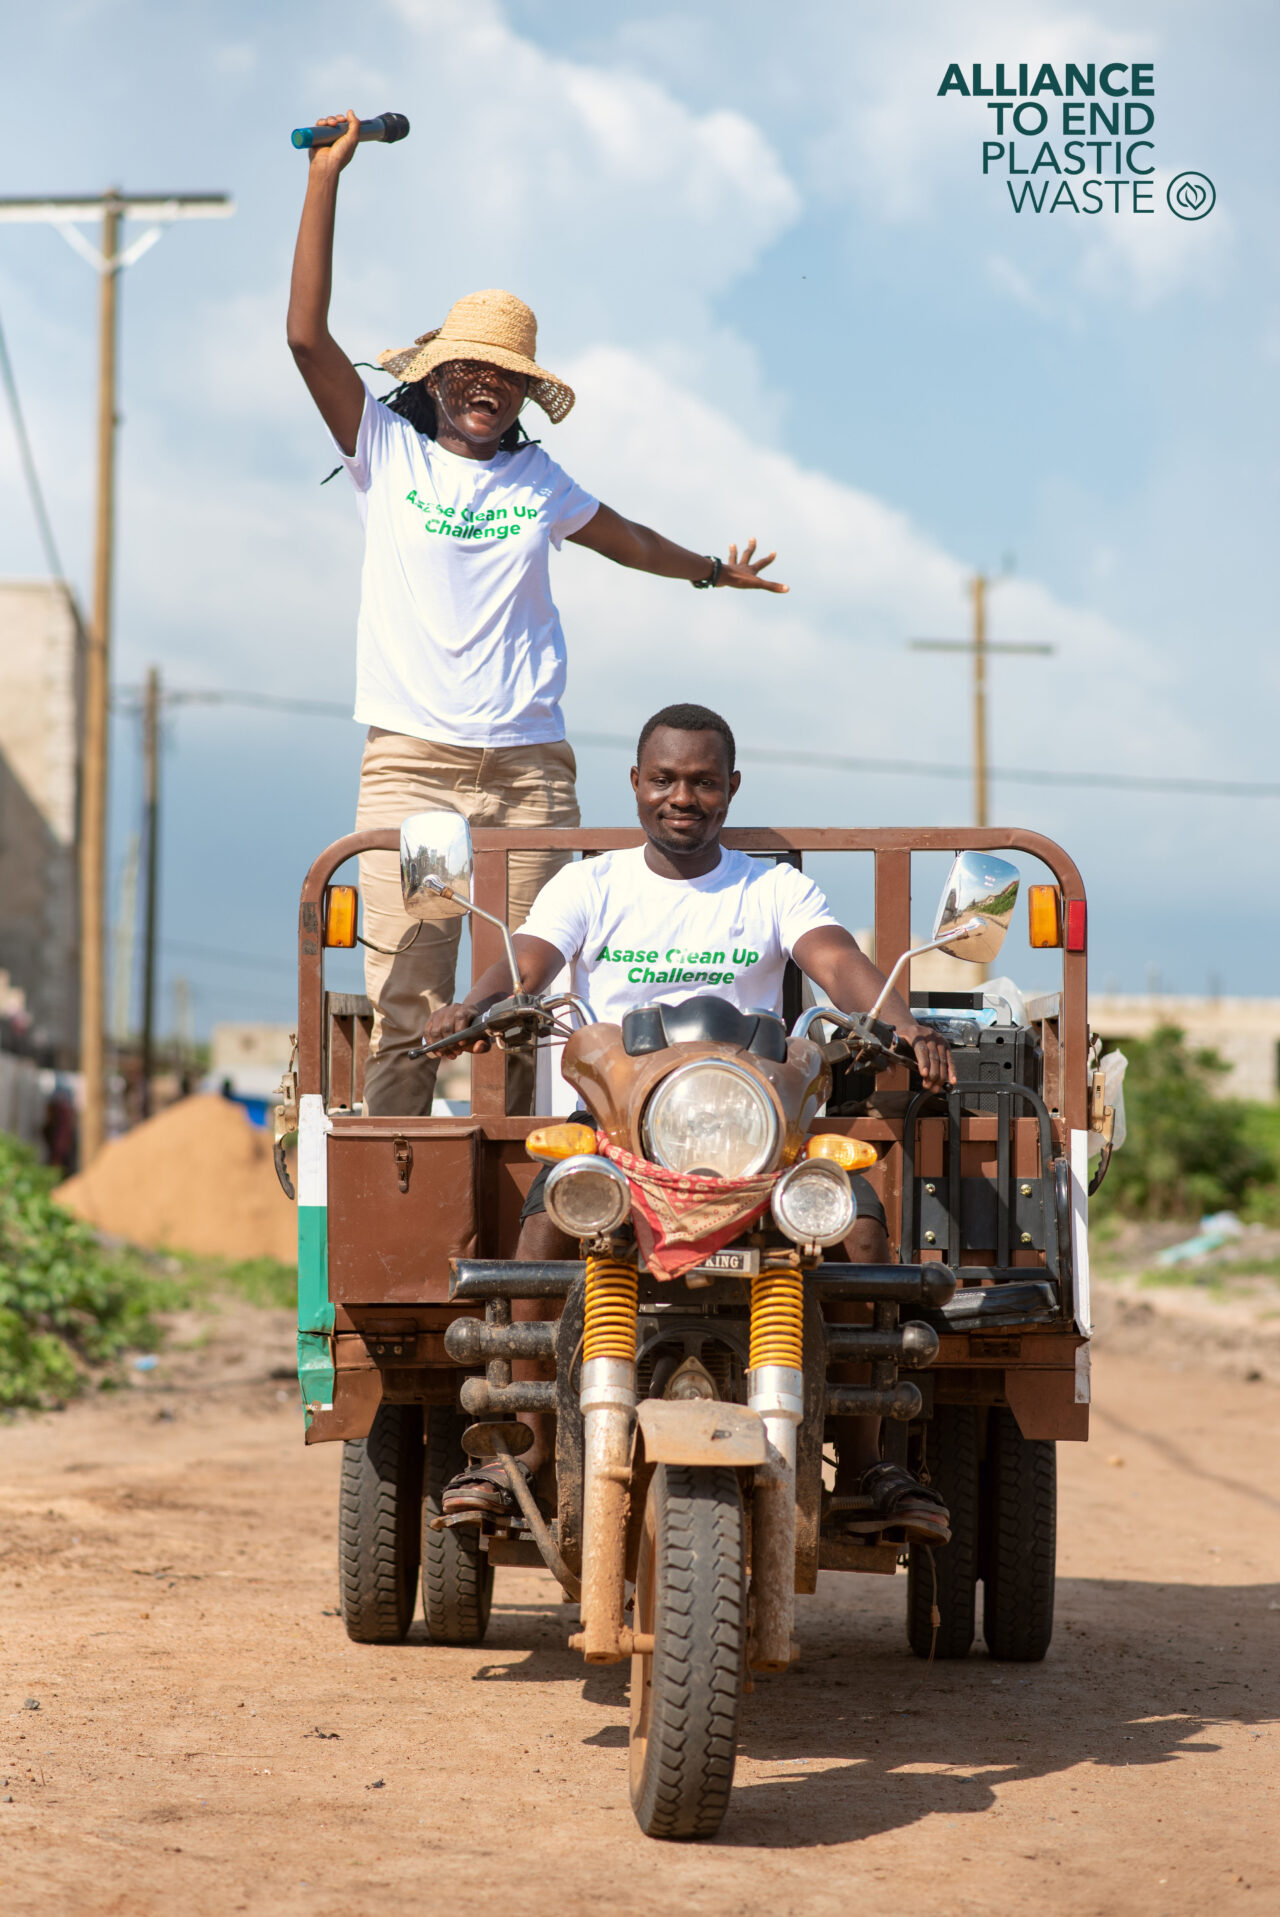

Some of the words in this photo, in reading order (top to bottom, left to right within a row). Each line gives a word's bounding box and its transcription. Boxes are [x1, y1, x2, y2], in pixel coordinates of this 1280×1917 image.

[460, 507, 508, 523] Clean
[513, 505, 538, 520] Up
[425, 518, 521, 540] Challenge
[595, 945, 659, 963] Asase
[665, 948, 726, 964] Clean
[732, 948, 760, 968] Up
[627, 967, 735, 985] Challenge
